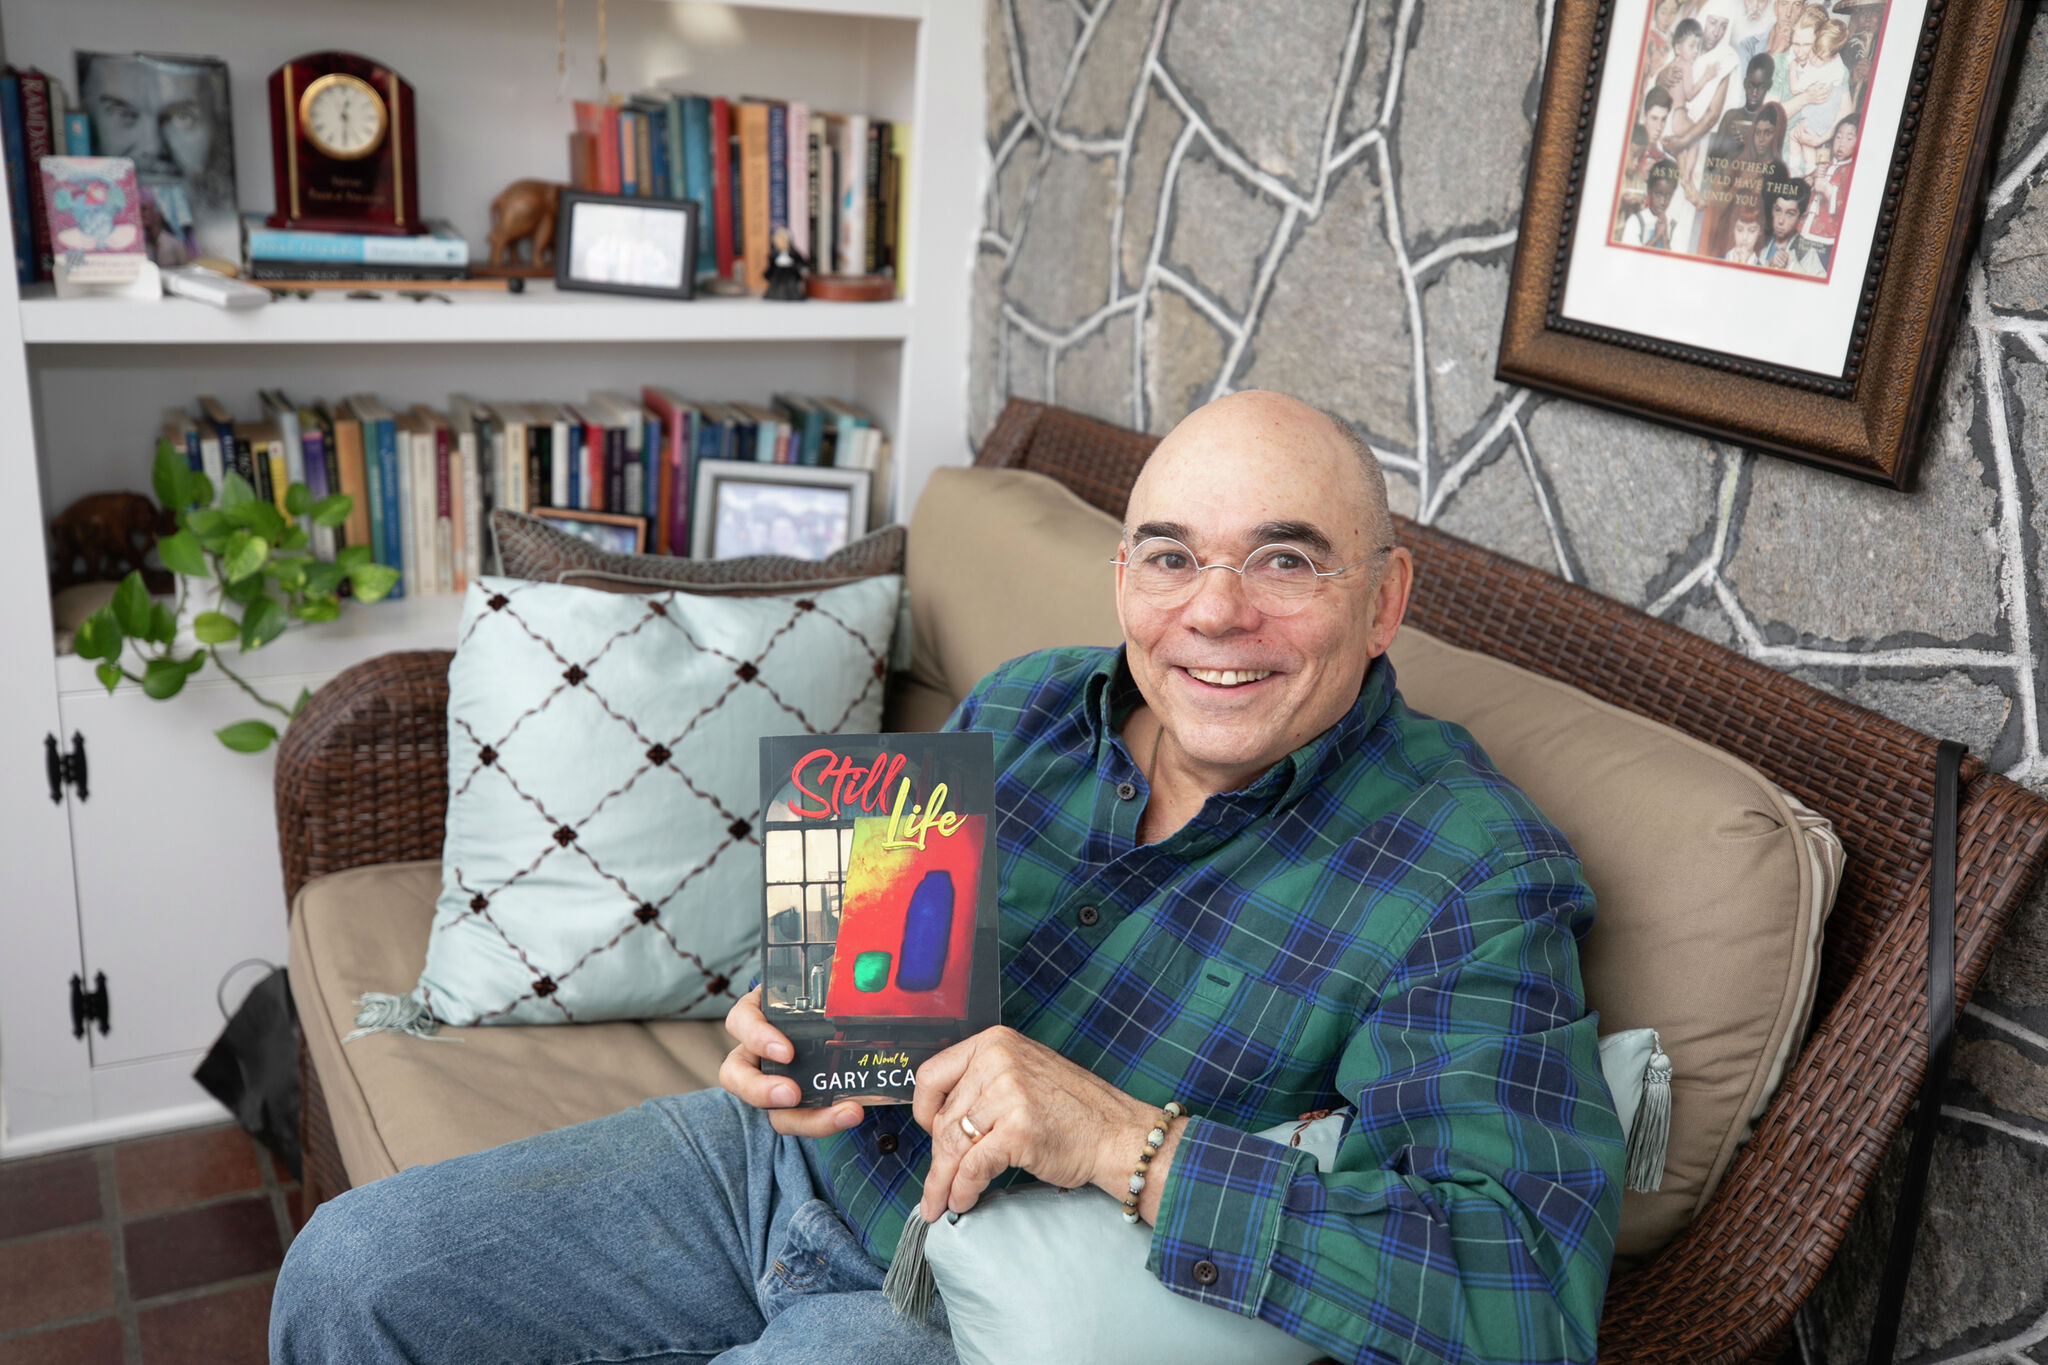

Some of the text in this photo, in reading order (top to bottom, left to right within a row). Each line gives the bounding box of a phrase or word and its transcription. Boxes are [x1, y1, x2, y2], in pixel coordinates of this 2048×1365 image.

[1706, 156, 1776, 175] NTO OTHERS
[1653, 167, 1666, 177] AS
[1703, 173, 1731, 185] OULD
[1734, 177, 1763, 190] HAVE
[1766, 182, 1799, 196] THEM
[1735, 193, 1758, 207] YOU
[788, 748, 907, 820] Still
[882, 777, 968, 851] Life
[857, 1051, 909, 1068] A Novel by
[813, 1069, 917, 1091] GARY SCA
